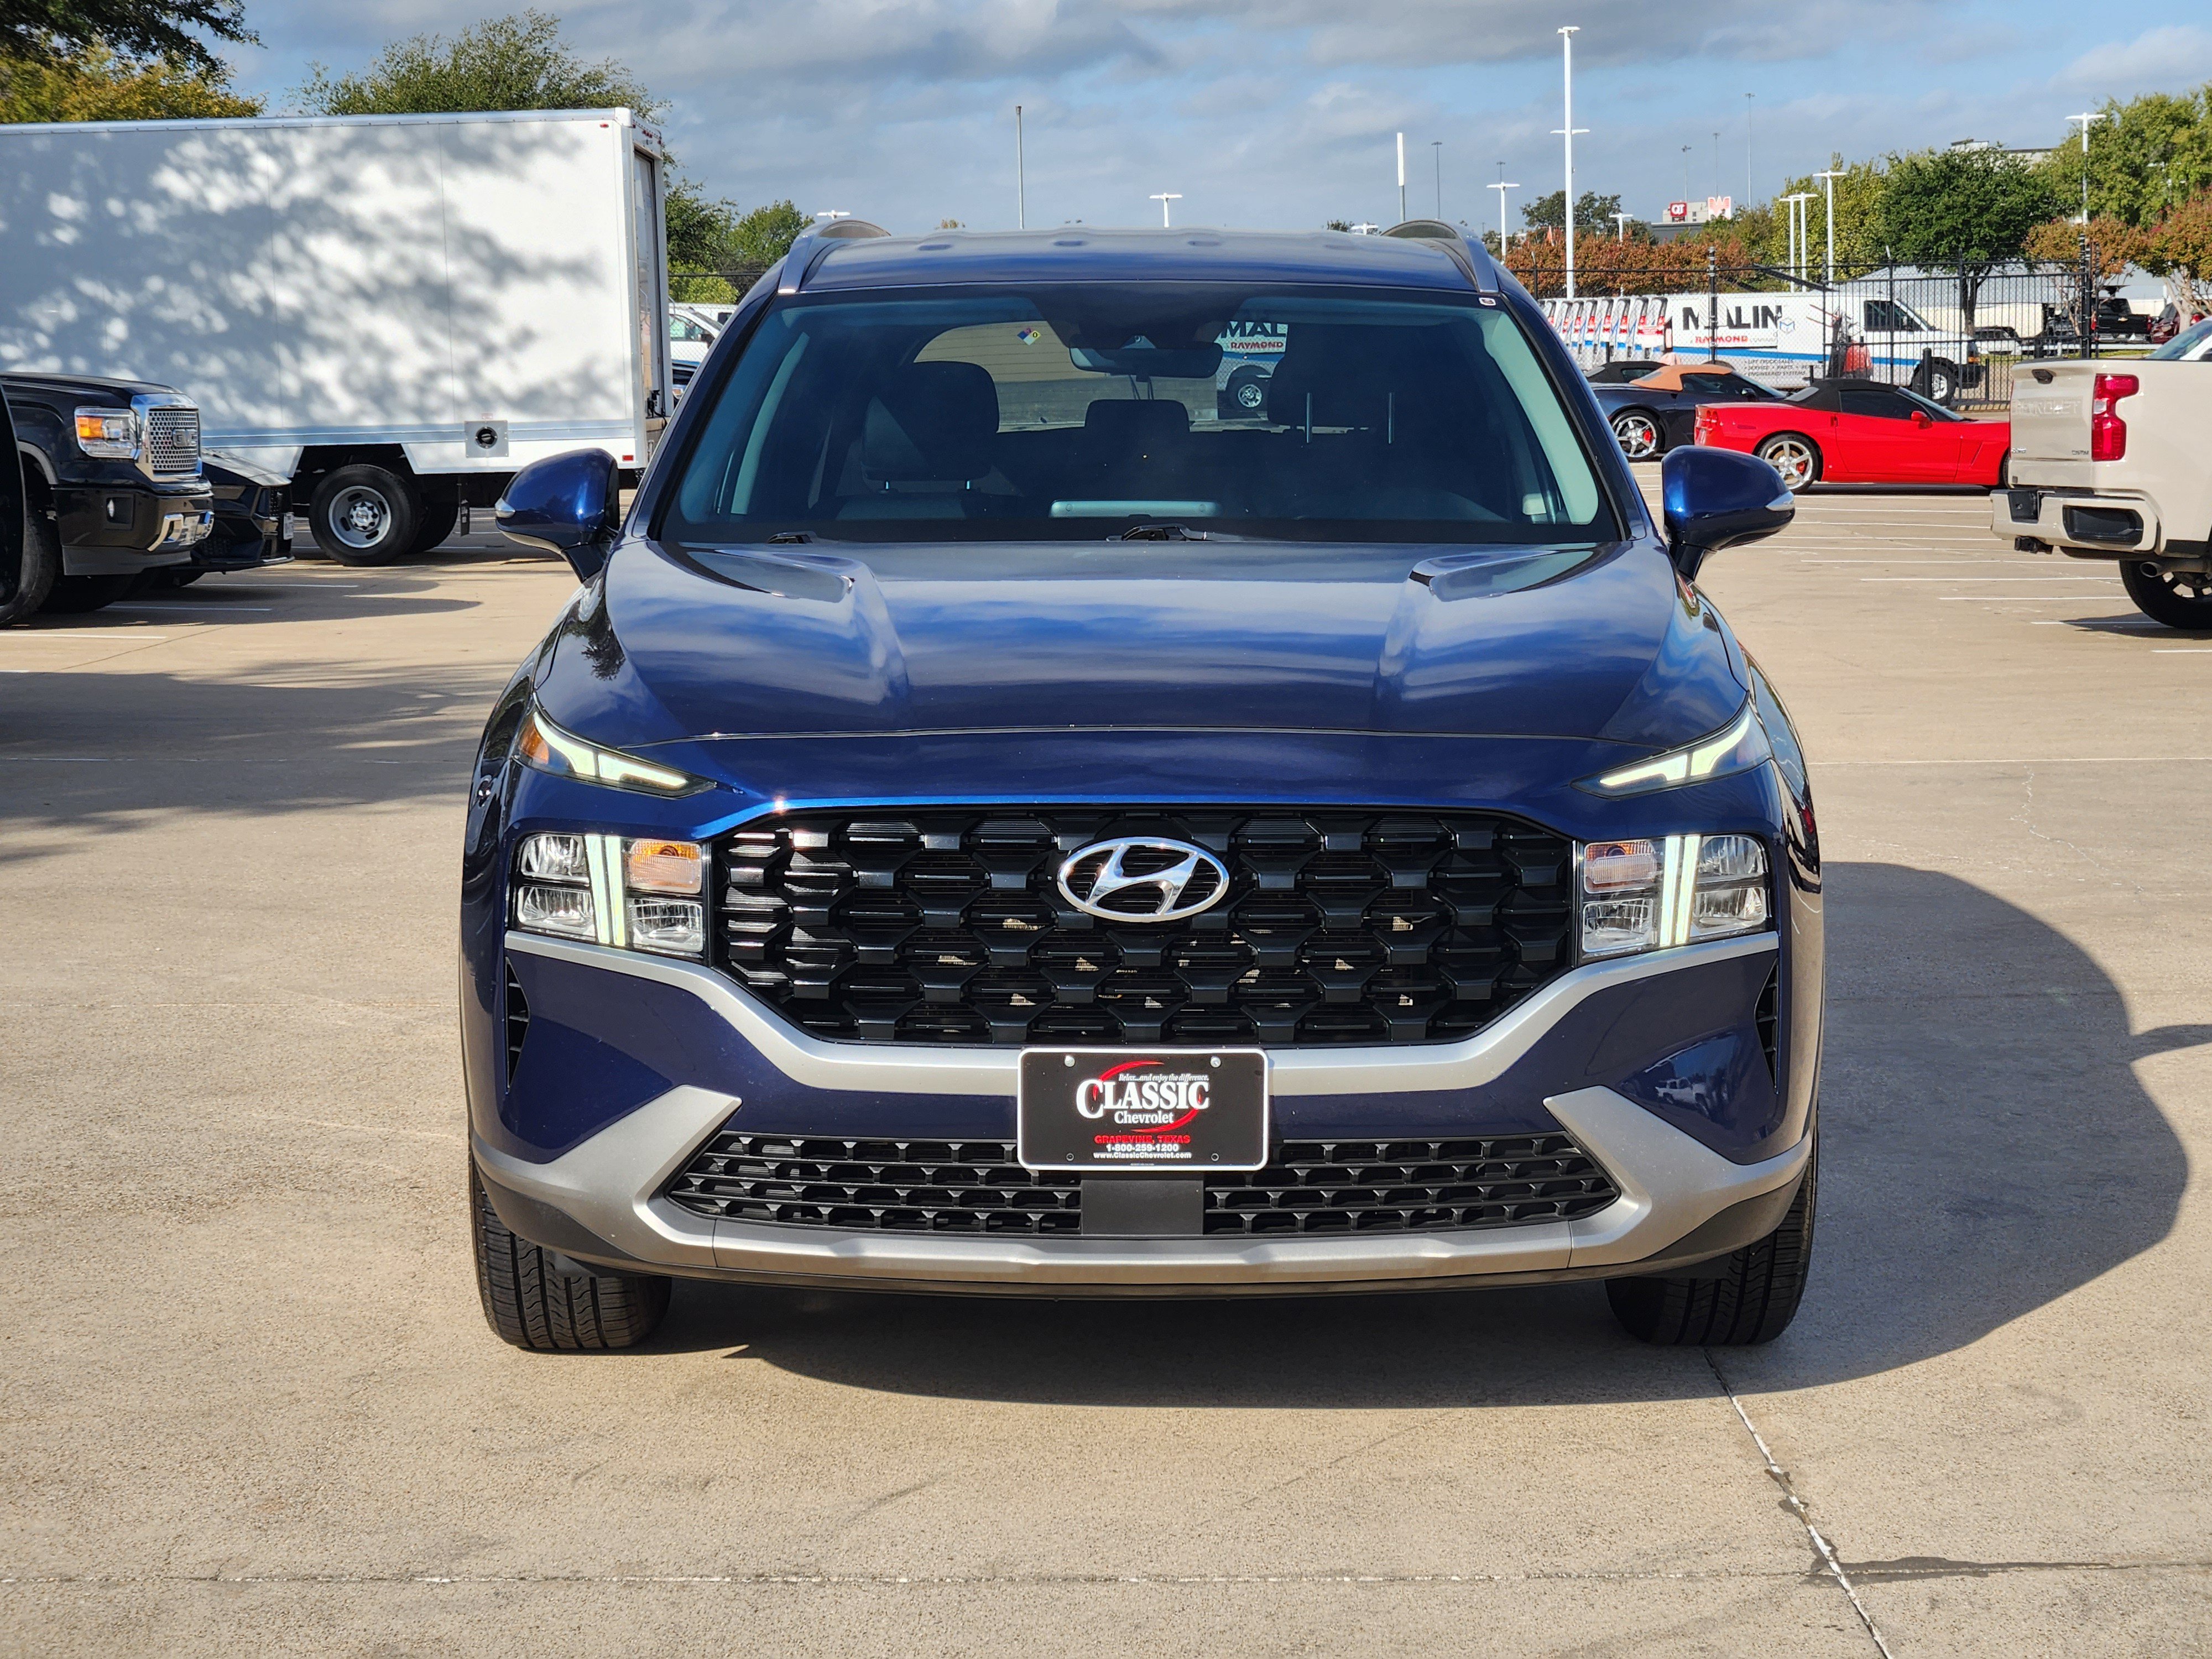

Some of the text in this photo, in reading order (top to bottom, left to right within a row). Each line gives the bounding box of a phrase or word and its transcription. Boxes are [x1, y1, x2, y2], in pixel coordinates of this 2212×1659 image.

[1152, 1074, 1168, 1083] enjoy
[1168, 1073, 1178, 1081] the
[1076, 1079, 1209, 1118] CLASSIC
[1114, 1110, 1174, 1124] Chevrolet
[1094, 1135, 1191, 1144] GRAPEVINE, TEXAS
[1106, 1144, 1179, 1152] 1-800-259-1200
